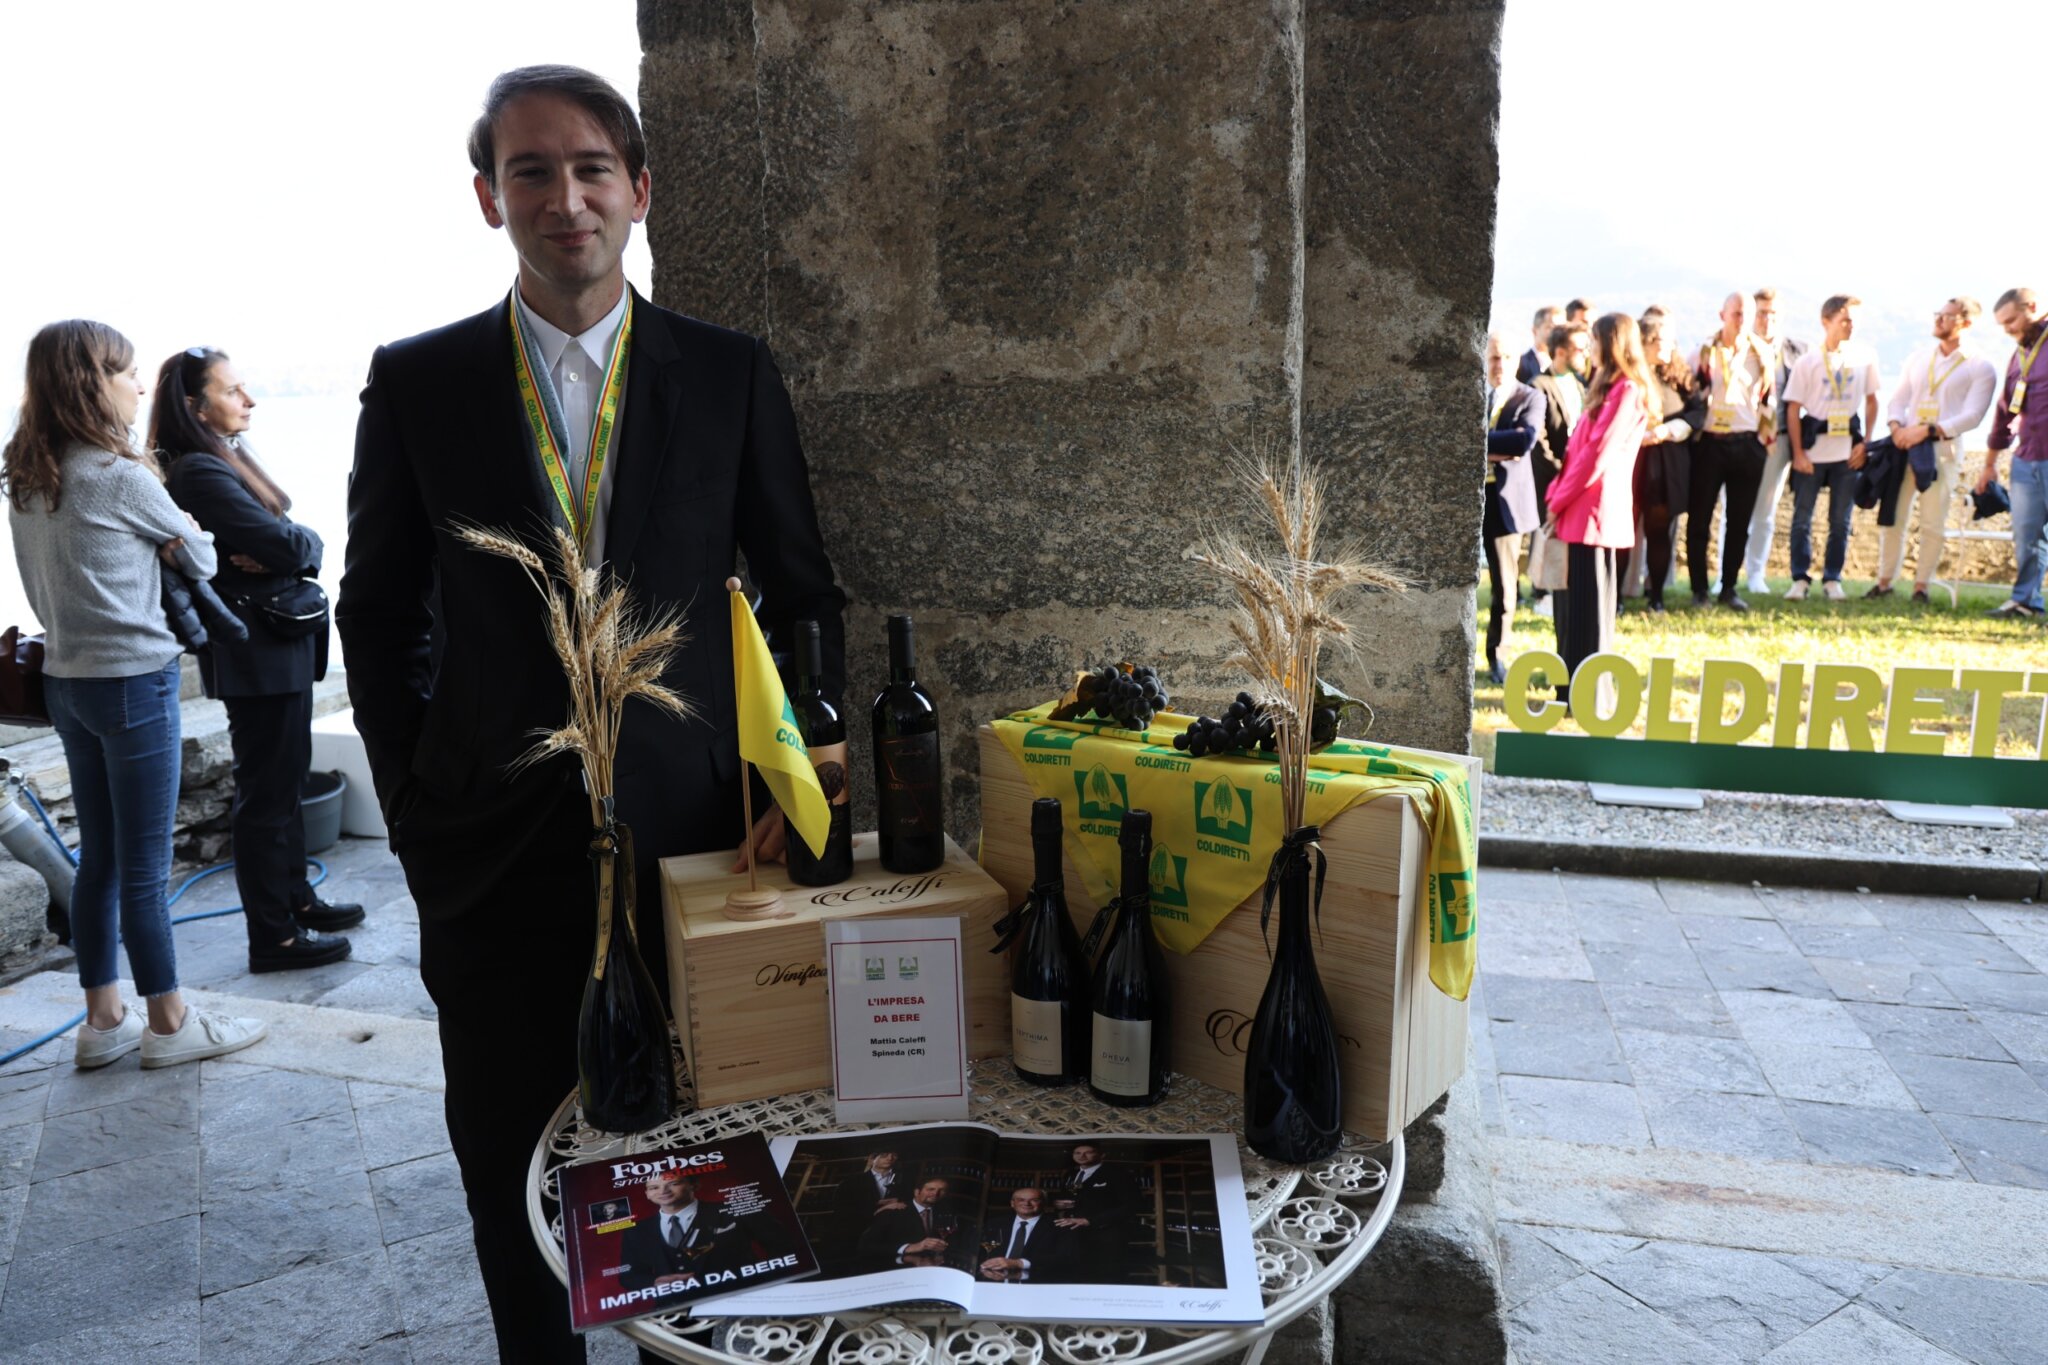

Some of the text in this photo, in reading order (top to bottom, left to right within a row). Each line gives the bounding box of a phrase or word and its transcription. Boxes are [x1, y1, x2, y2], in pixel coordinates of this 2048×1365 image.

[526, 399, 549, 449] COLDIRETTI
[596, 412, 613, 462] COLDIRETTI
[1024, 752, 1071, 766] COLDIRETTI
[1135, 755, 1192, 773] COLDIRETTI
[1079, 823, 1121, 838] COLDIRE
[1197, 839, 1250, 862] COLDIRETTI
[867, 996, 926, 1007] L'IMPRESA
[873, 1013, 921, 1024] DA BERE
[870, 1036, 926, 1045] Mattia Caleffi
[871, 1048, 926, 1058] Spineda (CR)
[610, 1150, 725, 1181] Forbes
[600, 1277, 701, 1310] IMPRESA
[704, 1269, 737, 1286] DA
[740, 1253, 800, 1278] BERE
